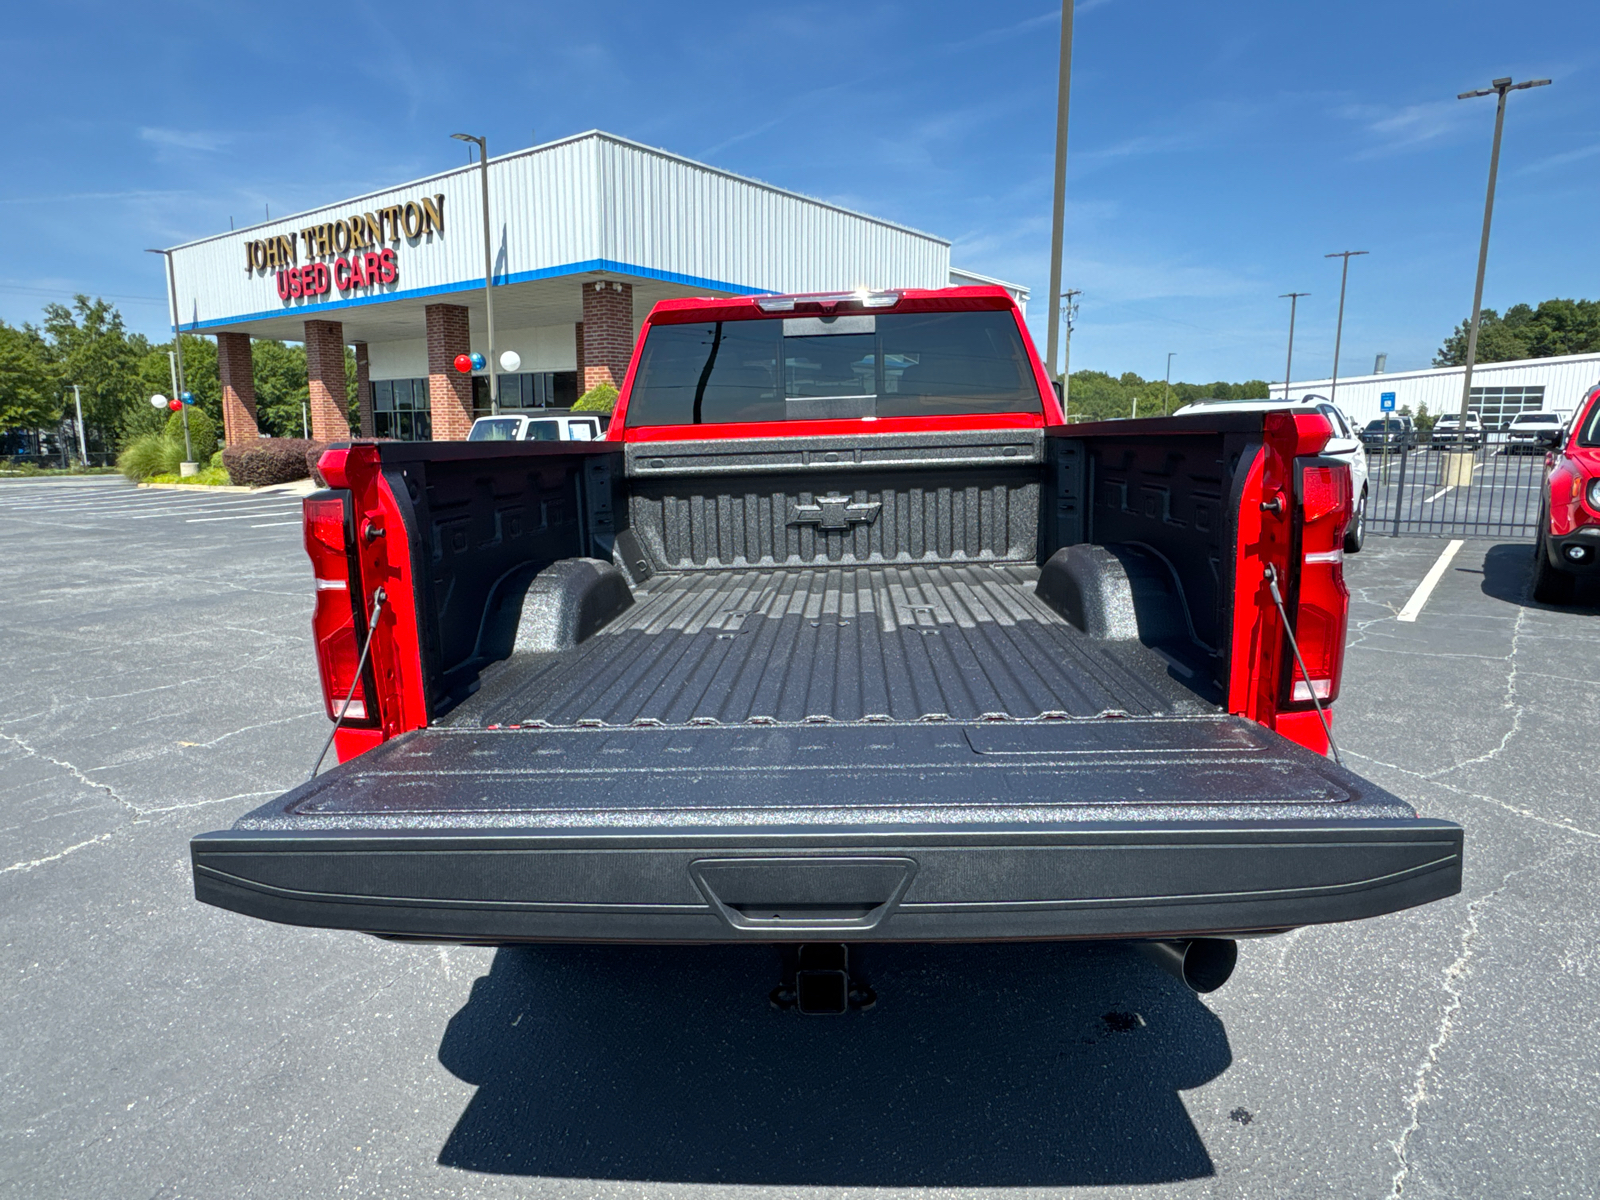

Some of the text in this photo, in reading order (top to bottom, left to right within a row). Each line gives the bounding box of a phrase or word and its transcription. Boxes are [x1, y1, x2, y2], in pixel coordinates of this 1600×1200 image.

[244, 194, 445, 273] JOHN THORNTON
[276, 247, 397, 300] USED CARS
